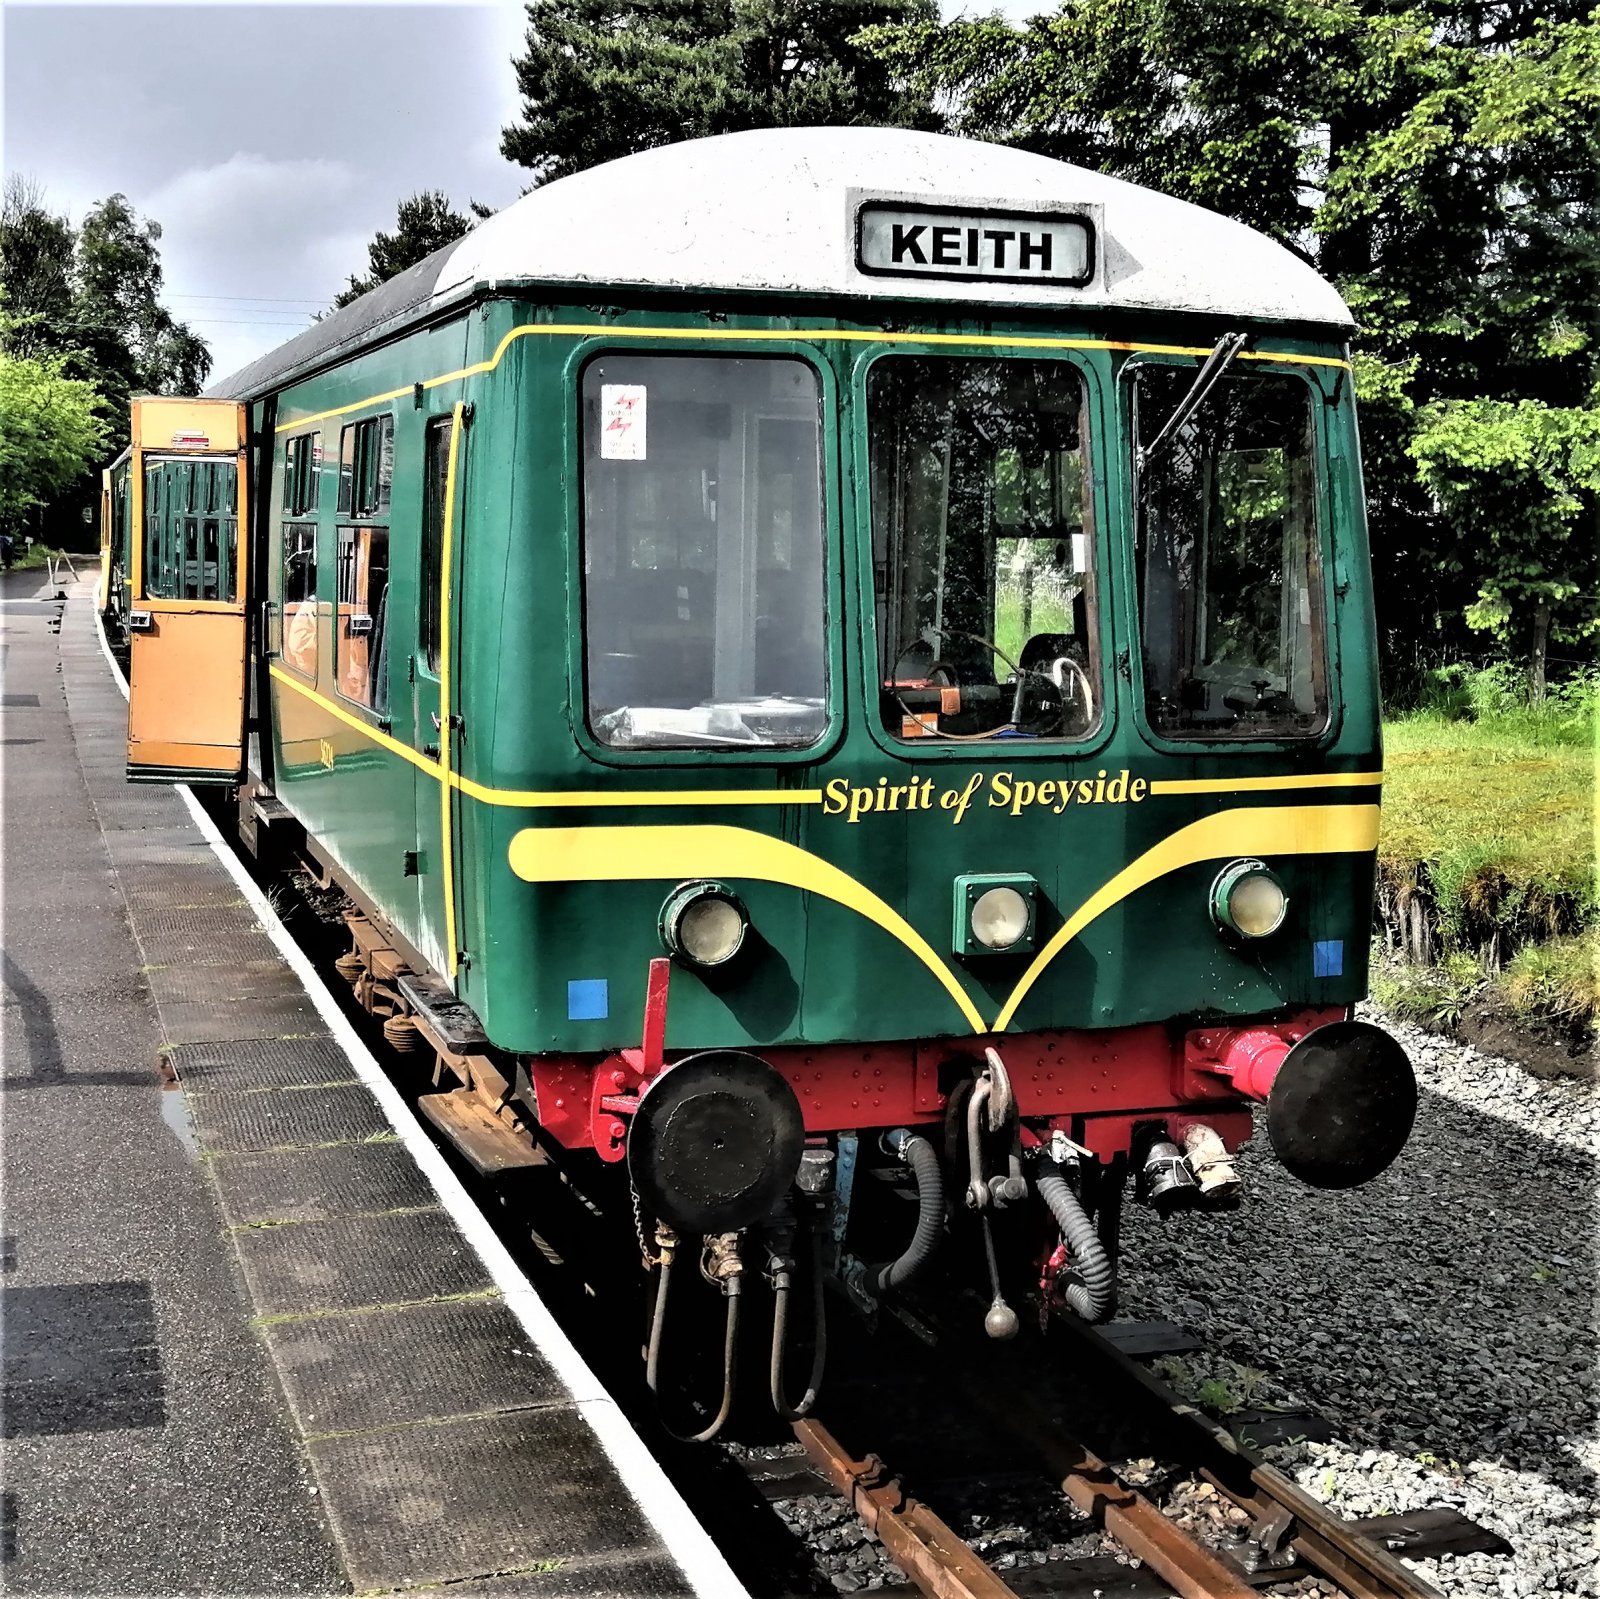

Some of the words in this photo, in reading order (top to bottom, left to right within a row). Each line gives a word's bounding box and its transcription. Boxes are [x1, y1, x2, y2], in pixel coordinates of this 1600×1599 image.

[892, 224, 1052, 271] KEITH
[823, 775, 935, 823] Spirit
[940, 772, 983, 824] of
[989, 769, 1147, 816] Speyside
